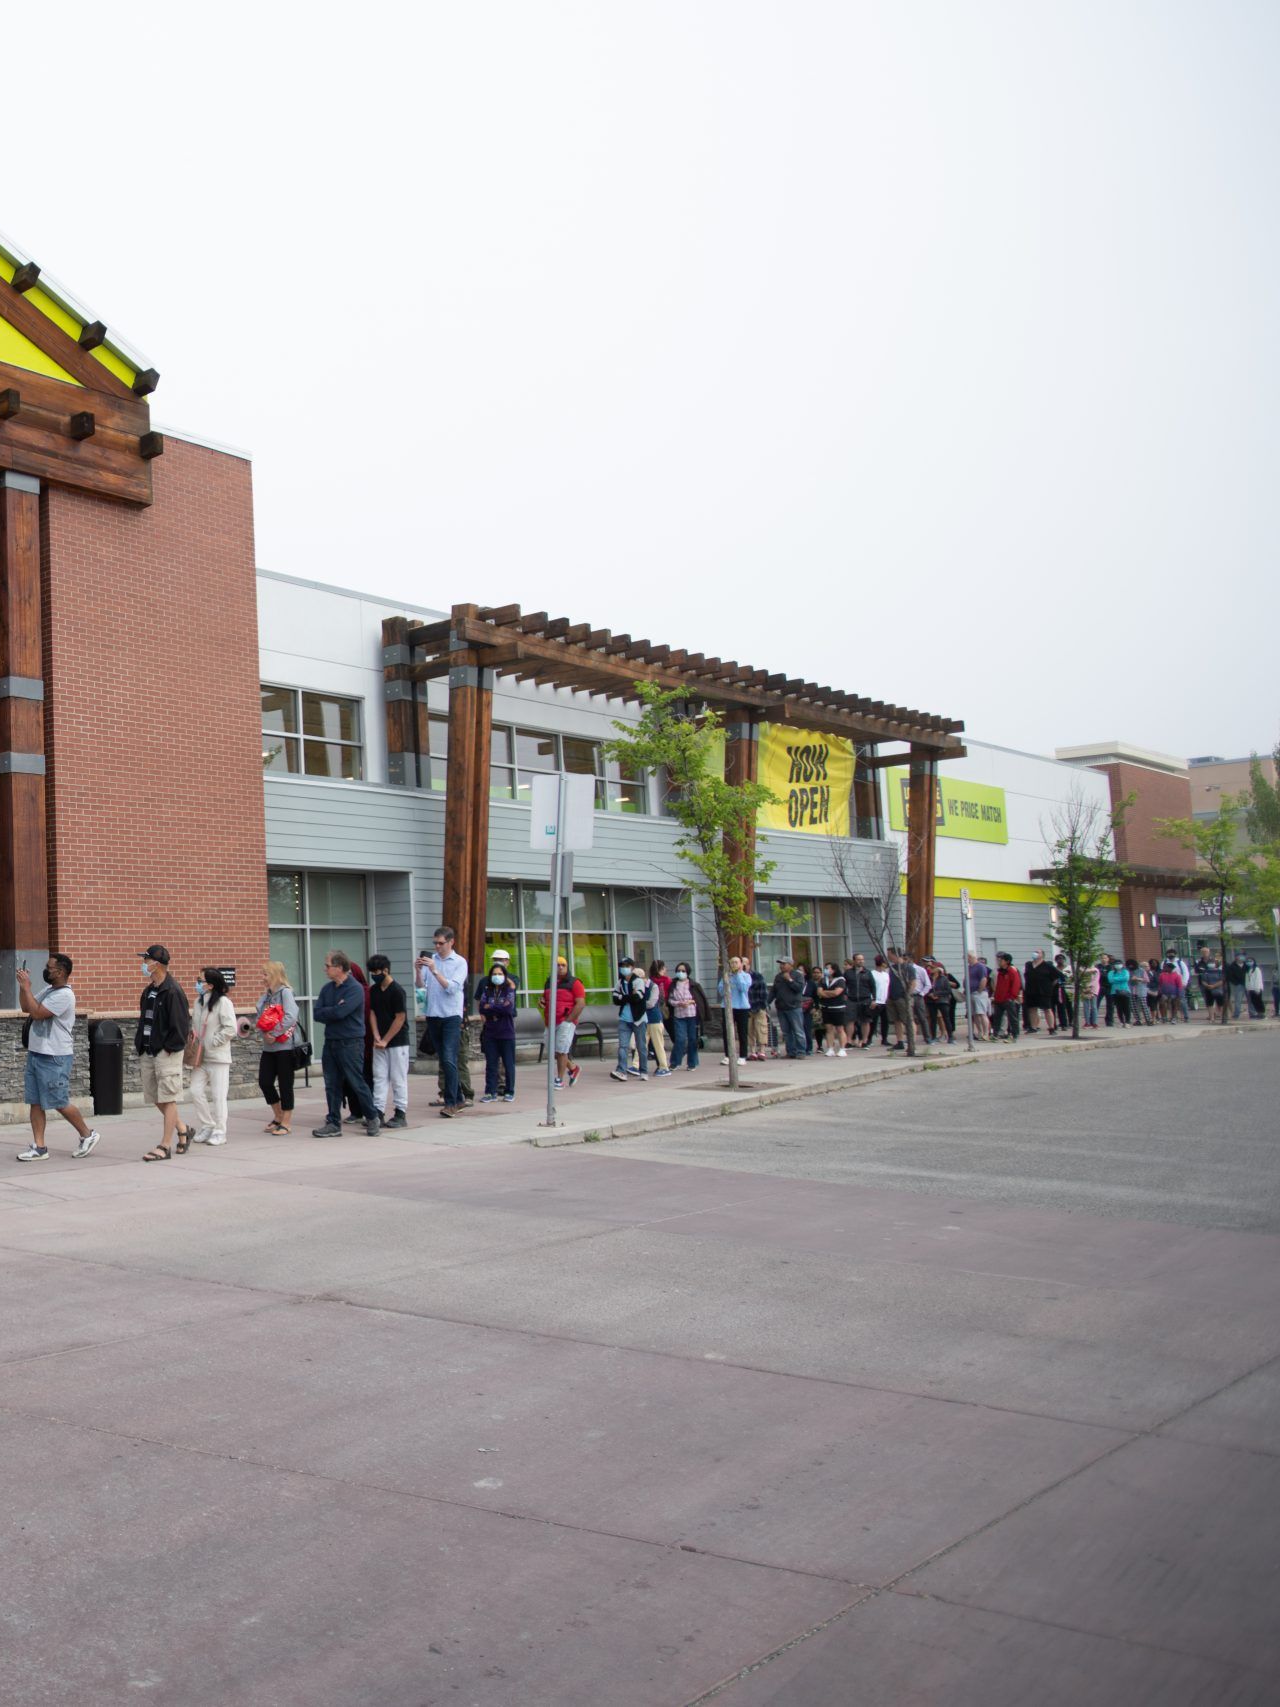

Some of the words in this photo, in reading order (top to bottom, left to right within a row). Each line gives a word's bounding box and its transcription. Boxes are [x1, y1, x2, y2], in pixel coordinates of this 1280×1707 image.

[786, 744, 829, 783] NOW
[788, 785, 830, 828] OPEN
[948, 799, 959, 817] WE
[960, 801, 980, 819] PRICE
[981, 804, 1002, 823] MATCH
